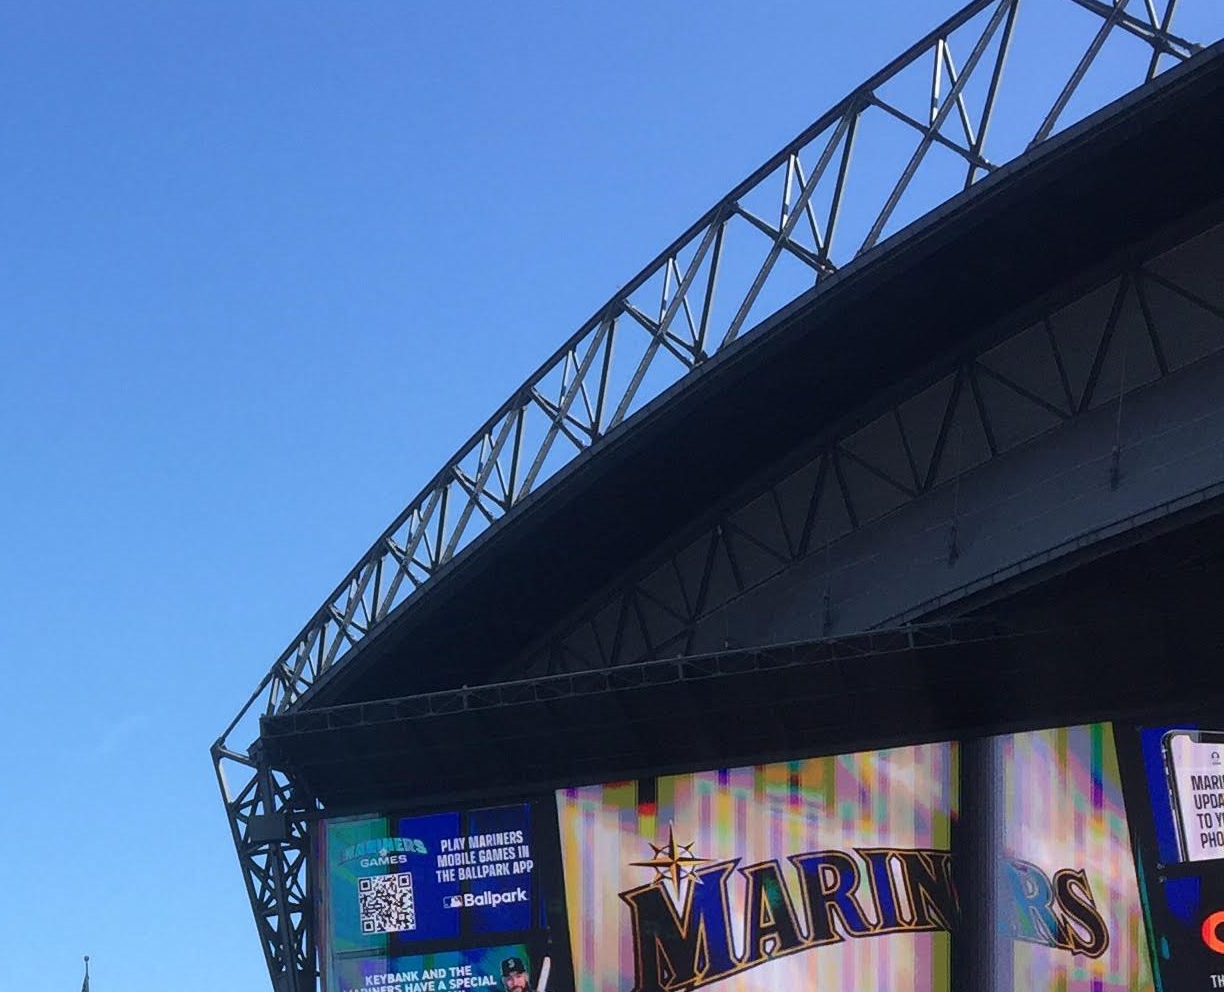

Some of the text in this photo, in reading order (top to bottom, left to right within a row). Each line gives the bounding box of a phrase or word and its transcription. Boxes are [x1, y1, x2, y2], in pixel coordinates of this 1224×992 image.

[1196, 812, 1213, 829] TO
[440, 830, 524, 852] PLAY MARINERS
[360, 854, 408, 868] GAMES
[436, 845, 530, 868] MOBILE GAMES IN
[435, 860, 534, 884] THE BALLPARK APP
[464, 887, 527, 908] Ballpark
[364, 965, 472, 986] KEYBANK AND THE
[438, 980, 447, 991] A
[449, 975, 497, 990] SPECIAL
